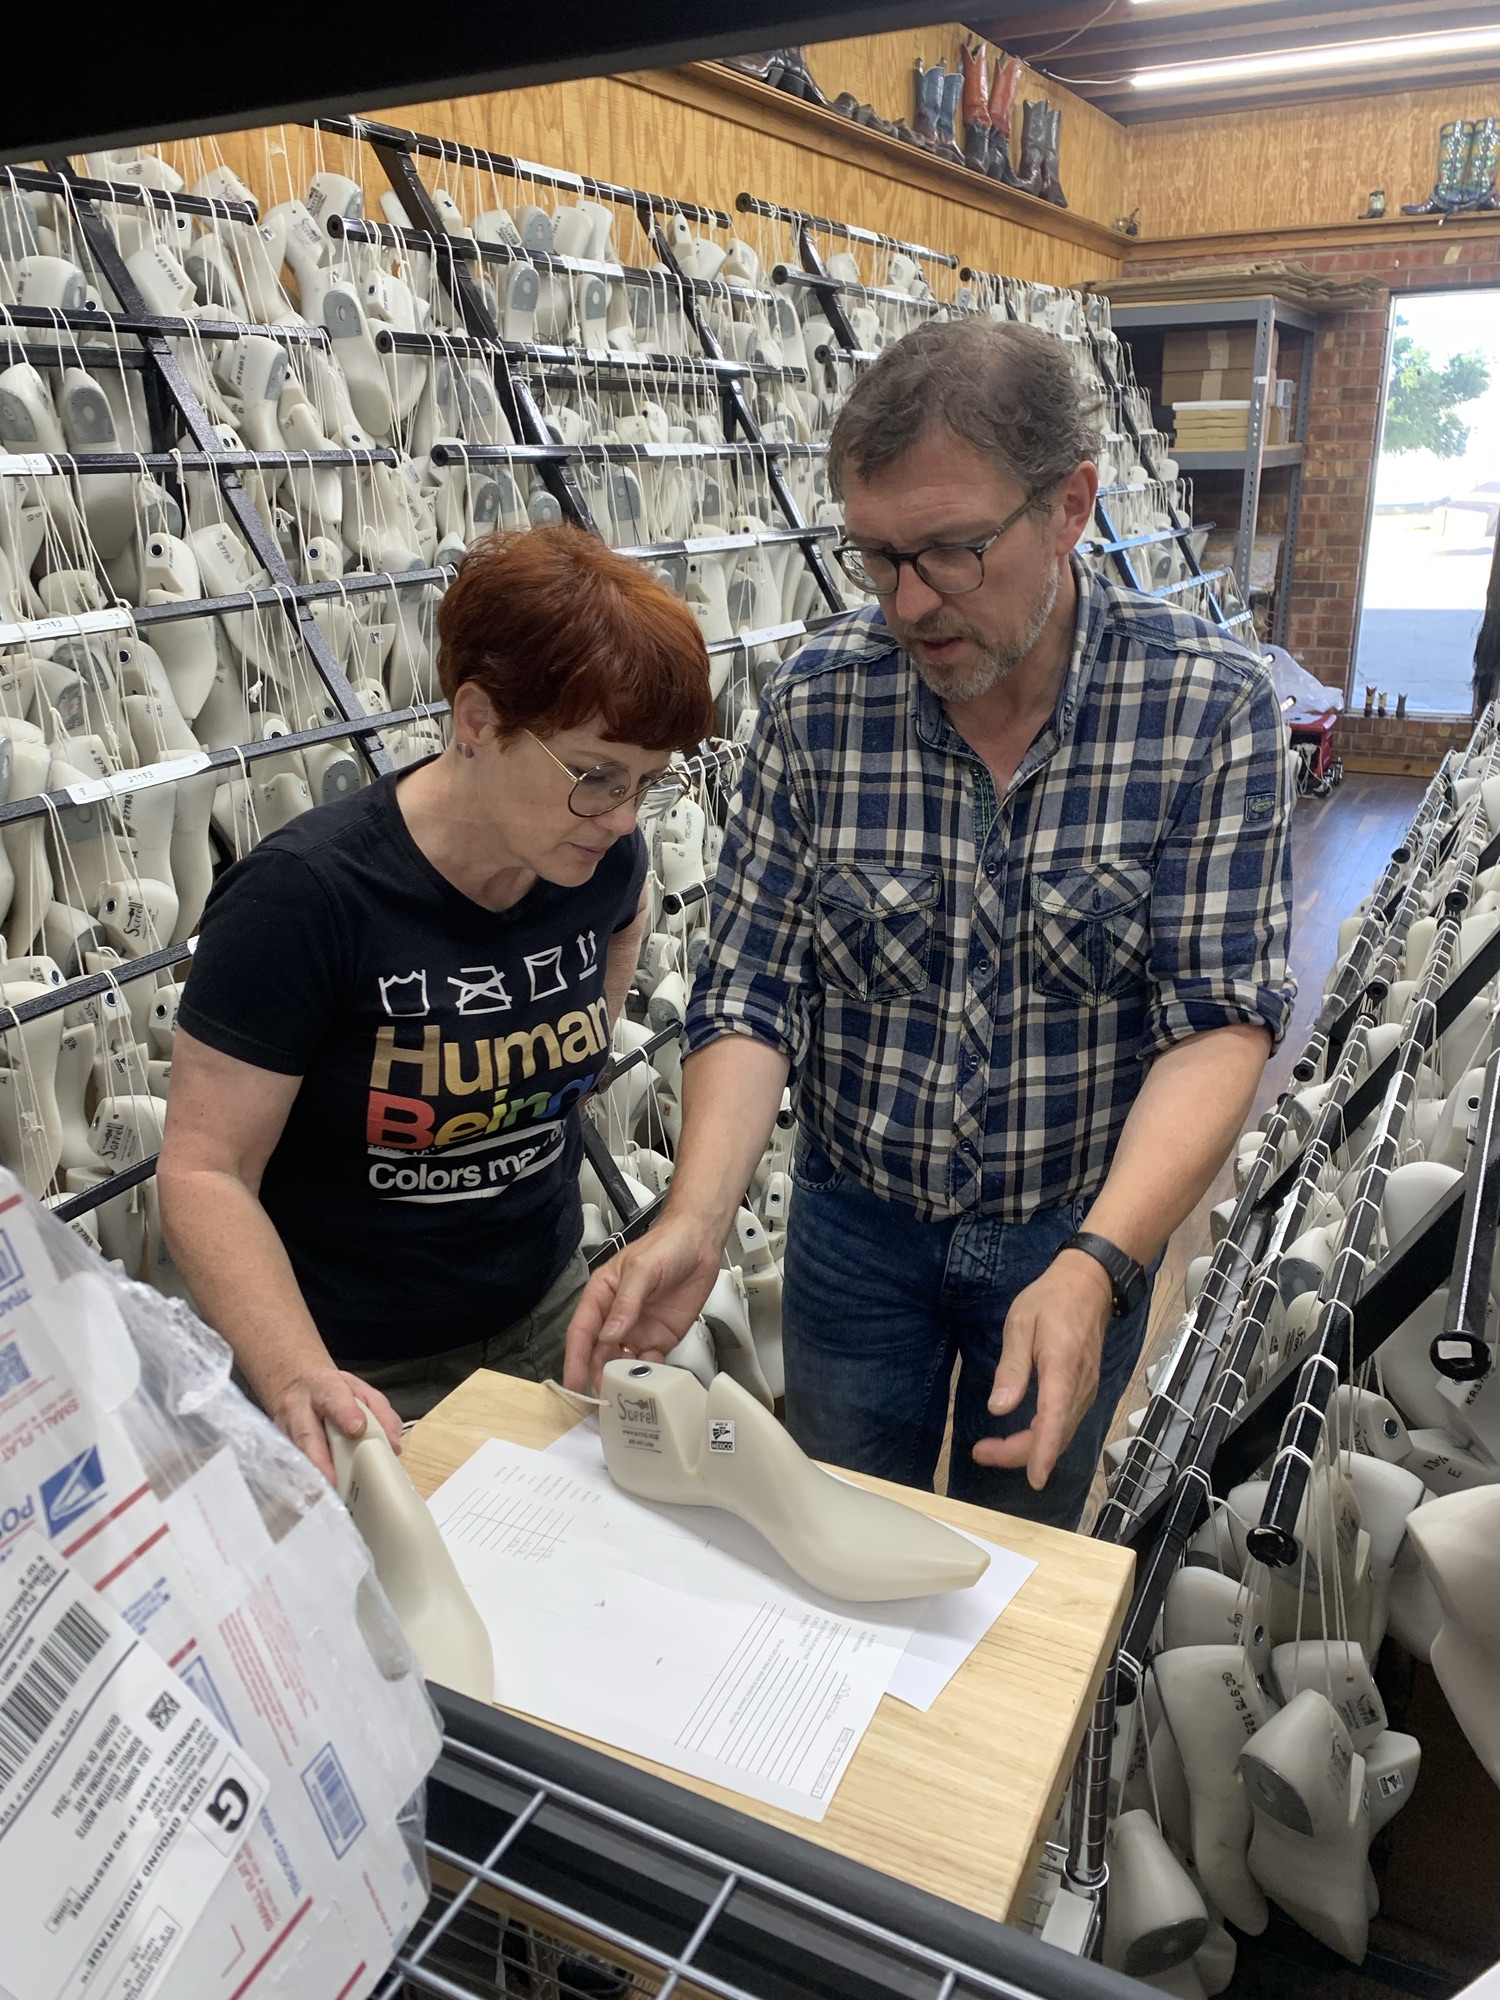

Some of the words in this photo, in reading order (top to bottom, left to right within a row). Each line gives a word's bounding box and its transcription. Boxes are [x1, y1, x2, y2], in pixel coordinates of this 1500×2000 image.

[216, 541, 235, 565] 27783
[122, 794, 133, 820] 27783
[123, 901, 144, 937] Sorrell
[370, 996, 608, 1096] Human
[97, 1122, 125, 1160] Sorrell
[369, 1163, 482, 1190] Colors
[71, 1222, 94, 1247] 27783
[617, 1393, 658, 1425] Sorrell
[711, 1441, 733, 1450] MEXICO
[1447, 1468, 1462, 1479] E
[1222, 1671, 1236, 1687] GC
[1230, 1689, 1248, 1712] 975
[1242, 1713, 1257, 1736] 125
[95, 1713, 119, 1750] GUTHRIE
[85, 1749, 116, 1797] OKLAHOMA
[116, 1736, 141, 1774] SORRELL
[136, 1745, 152, 1768] LISA
[94, 1772, 118, 1810] CUSTOM
[114, 1766, 139, 1804] SORRELL
[180, 1776, 206, 1815] USPS
[74, 1807, 97, 1841] BOOTS
[205, 1777, 250, 1834] G
[142, 1816, 181, 1877] GROUND
[70, 1851, 113, 1919] RESPONSE
